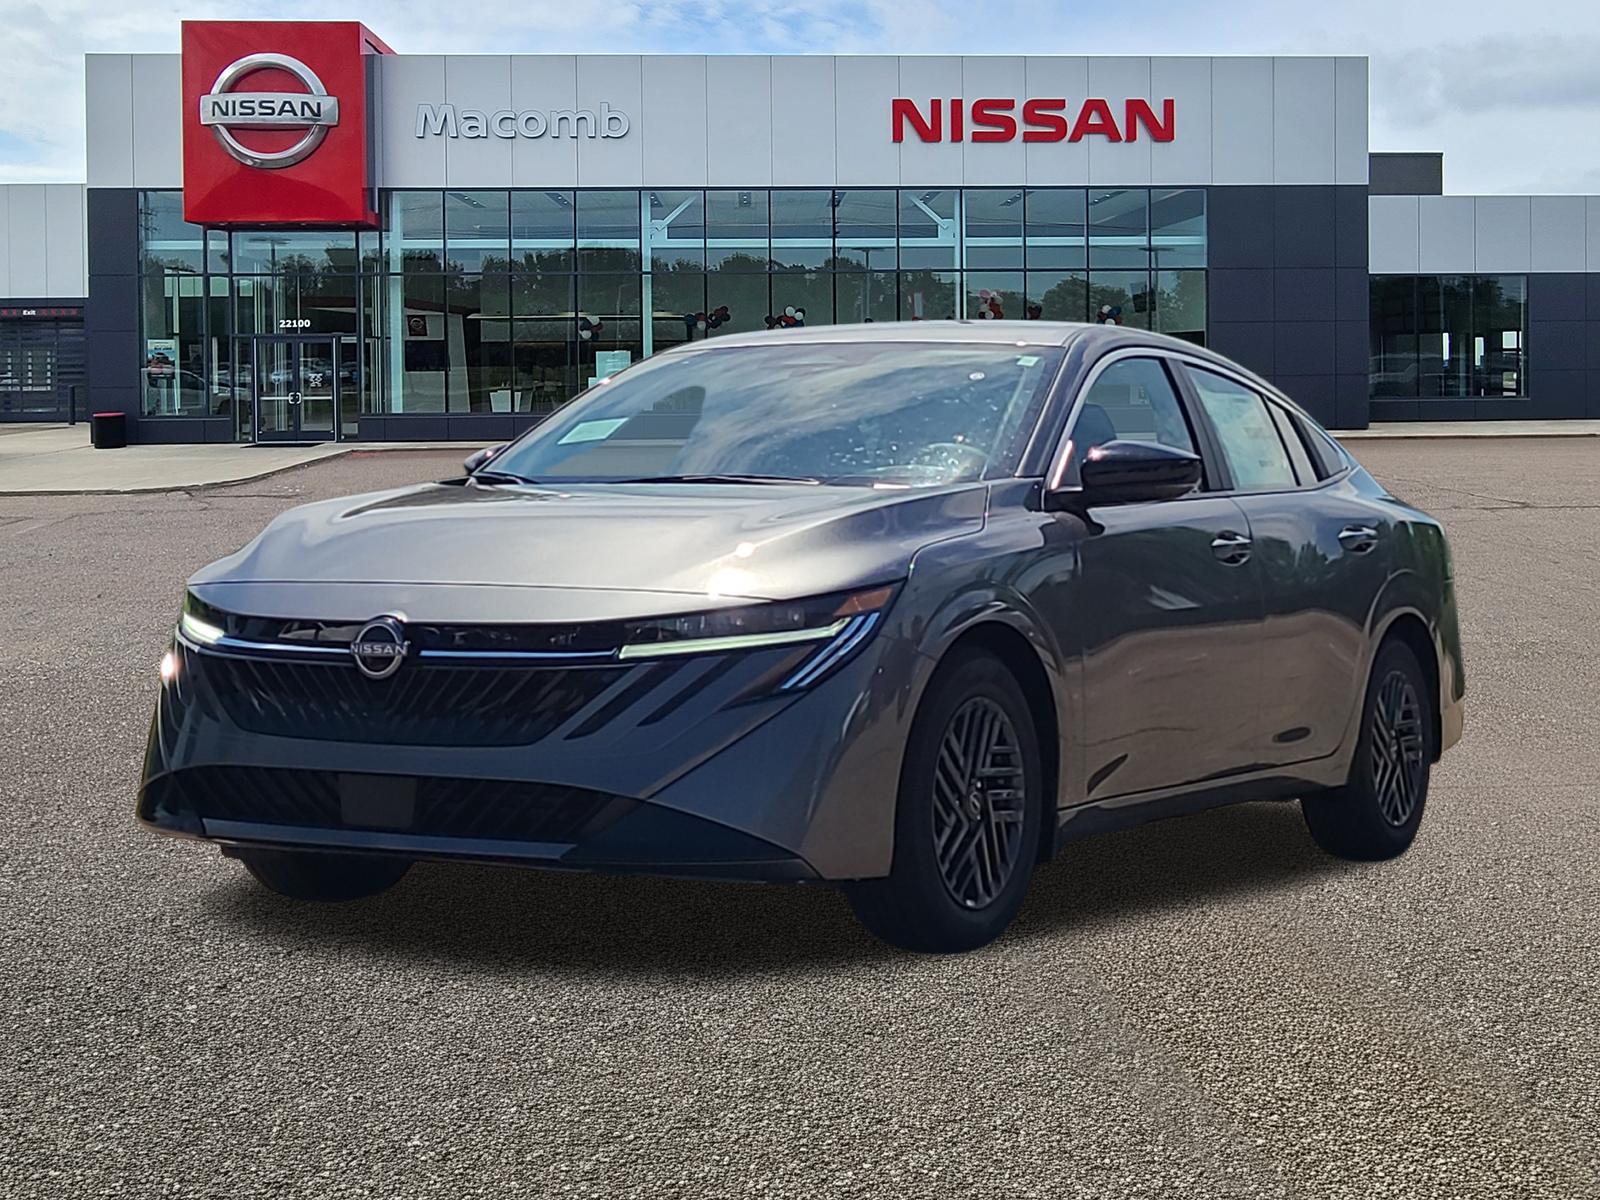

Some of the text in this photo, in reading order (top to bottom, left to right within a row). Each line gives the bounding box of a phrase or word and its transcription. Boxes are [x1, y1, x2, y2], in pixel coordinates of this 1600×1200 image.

[212, 100, 322, 118] NISSAN
[415, 102, 630, 139] Macomb
[892, 98, 1175, 143] NISSAN
[279, 319, 311, 328] 22100
[350, 643, 407, 656] NISSAN
